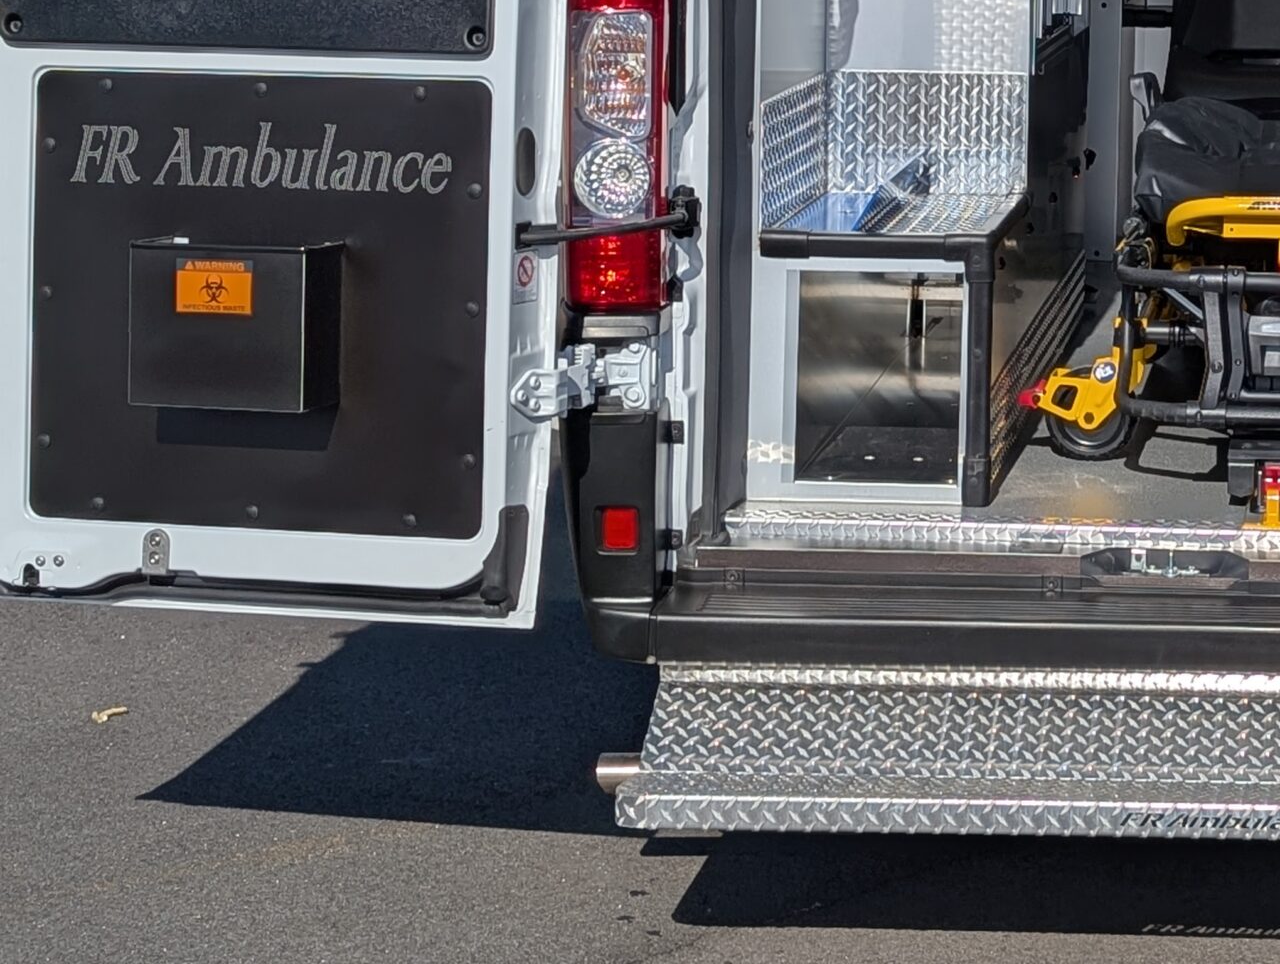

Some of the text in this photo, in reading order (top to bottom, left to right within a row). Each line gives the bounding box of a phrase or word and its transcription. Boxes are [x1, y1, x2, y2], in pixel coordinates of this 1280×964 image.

[70, 121, 452, 195] FR Ambulance
[194, 260, 245, 272] WARNING
[1120, 812, 1165, 828] FR
